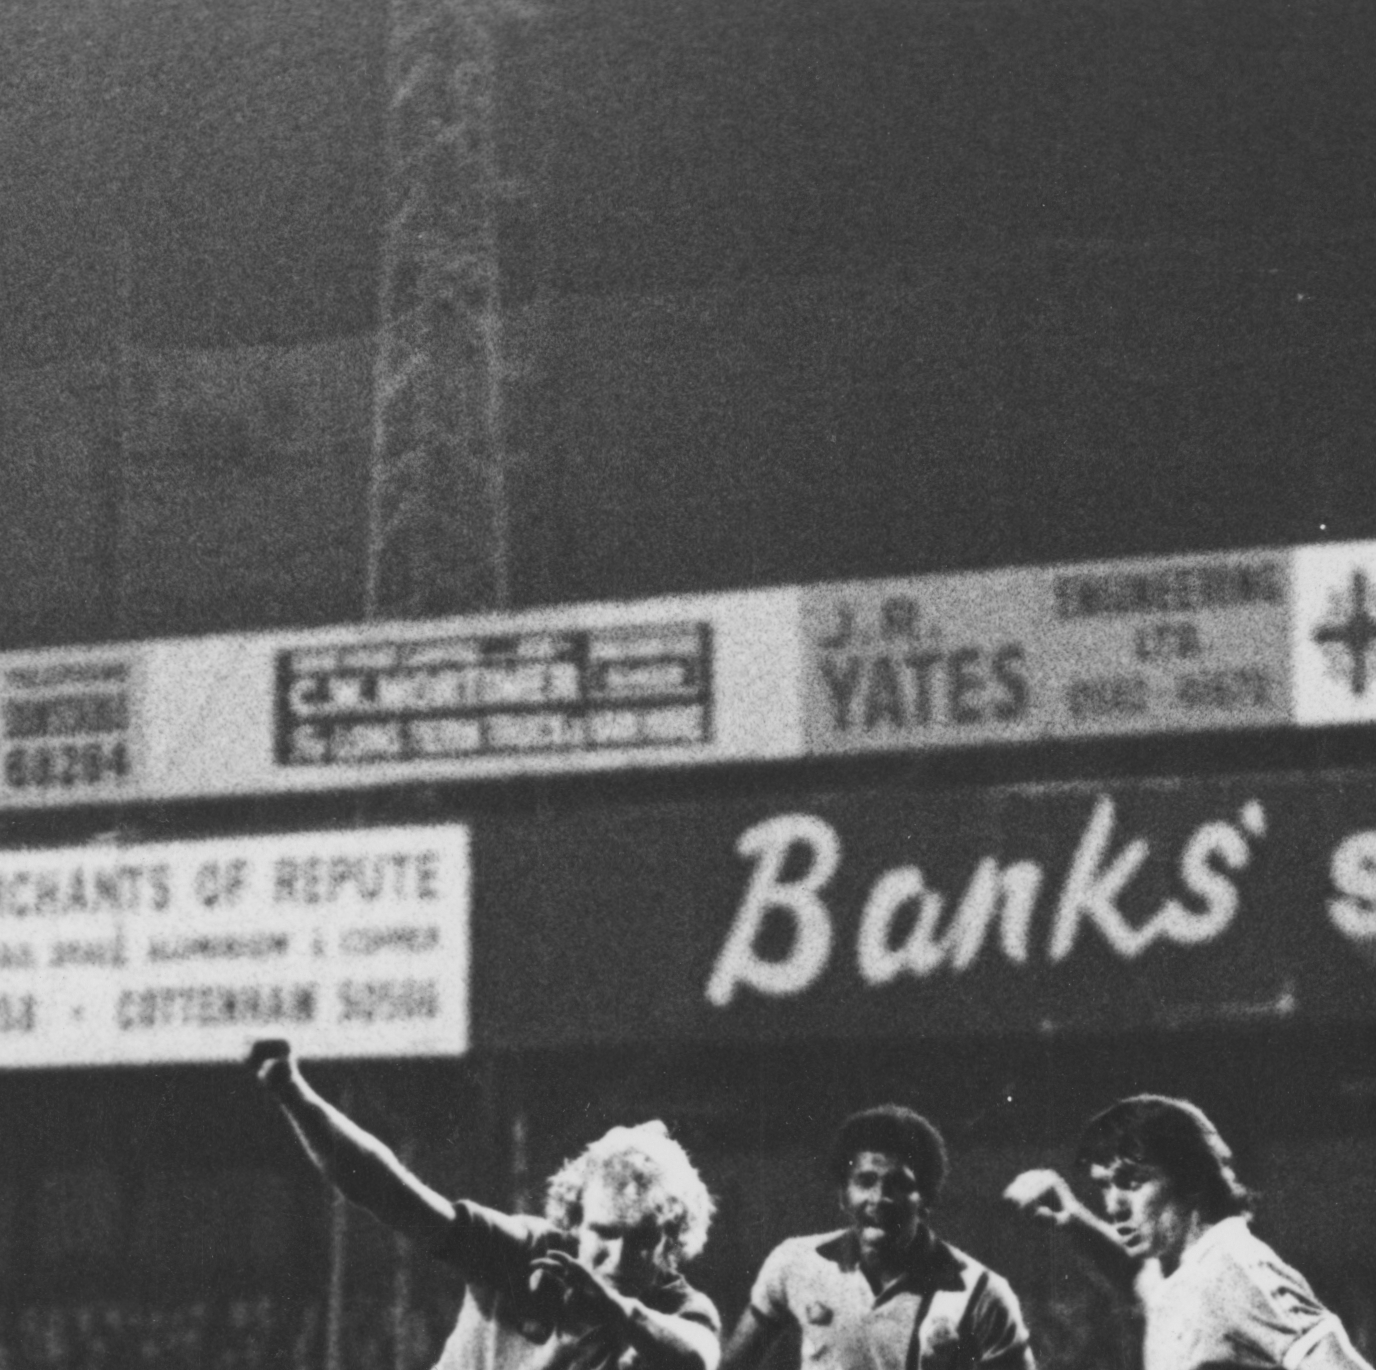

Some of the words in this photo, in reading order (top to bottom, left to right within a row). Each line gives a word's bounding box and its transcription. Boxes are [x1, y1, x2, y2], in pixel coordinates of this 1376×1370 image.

[822, 642, 1028, 732] YATES
[194, 856, 249, 908] OF
[272, 849, 440, 905] REPUTE
[703, 795, 1267, 1008] Banks'
